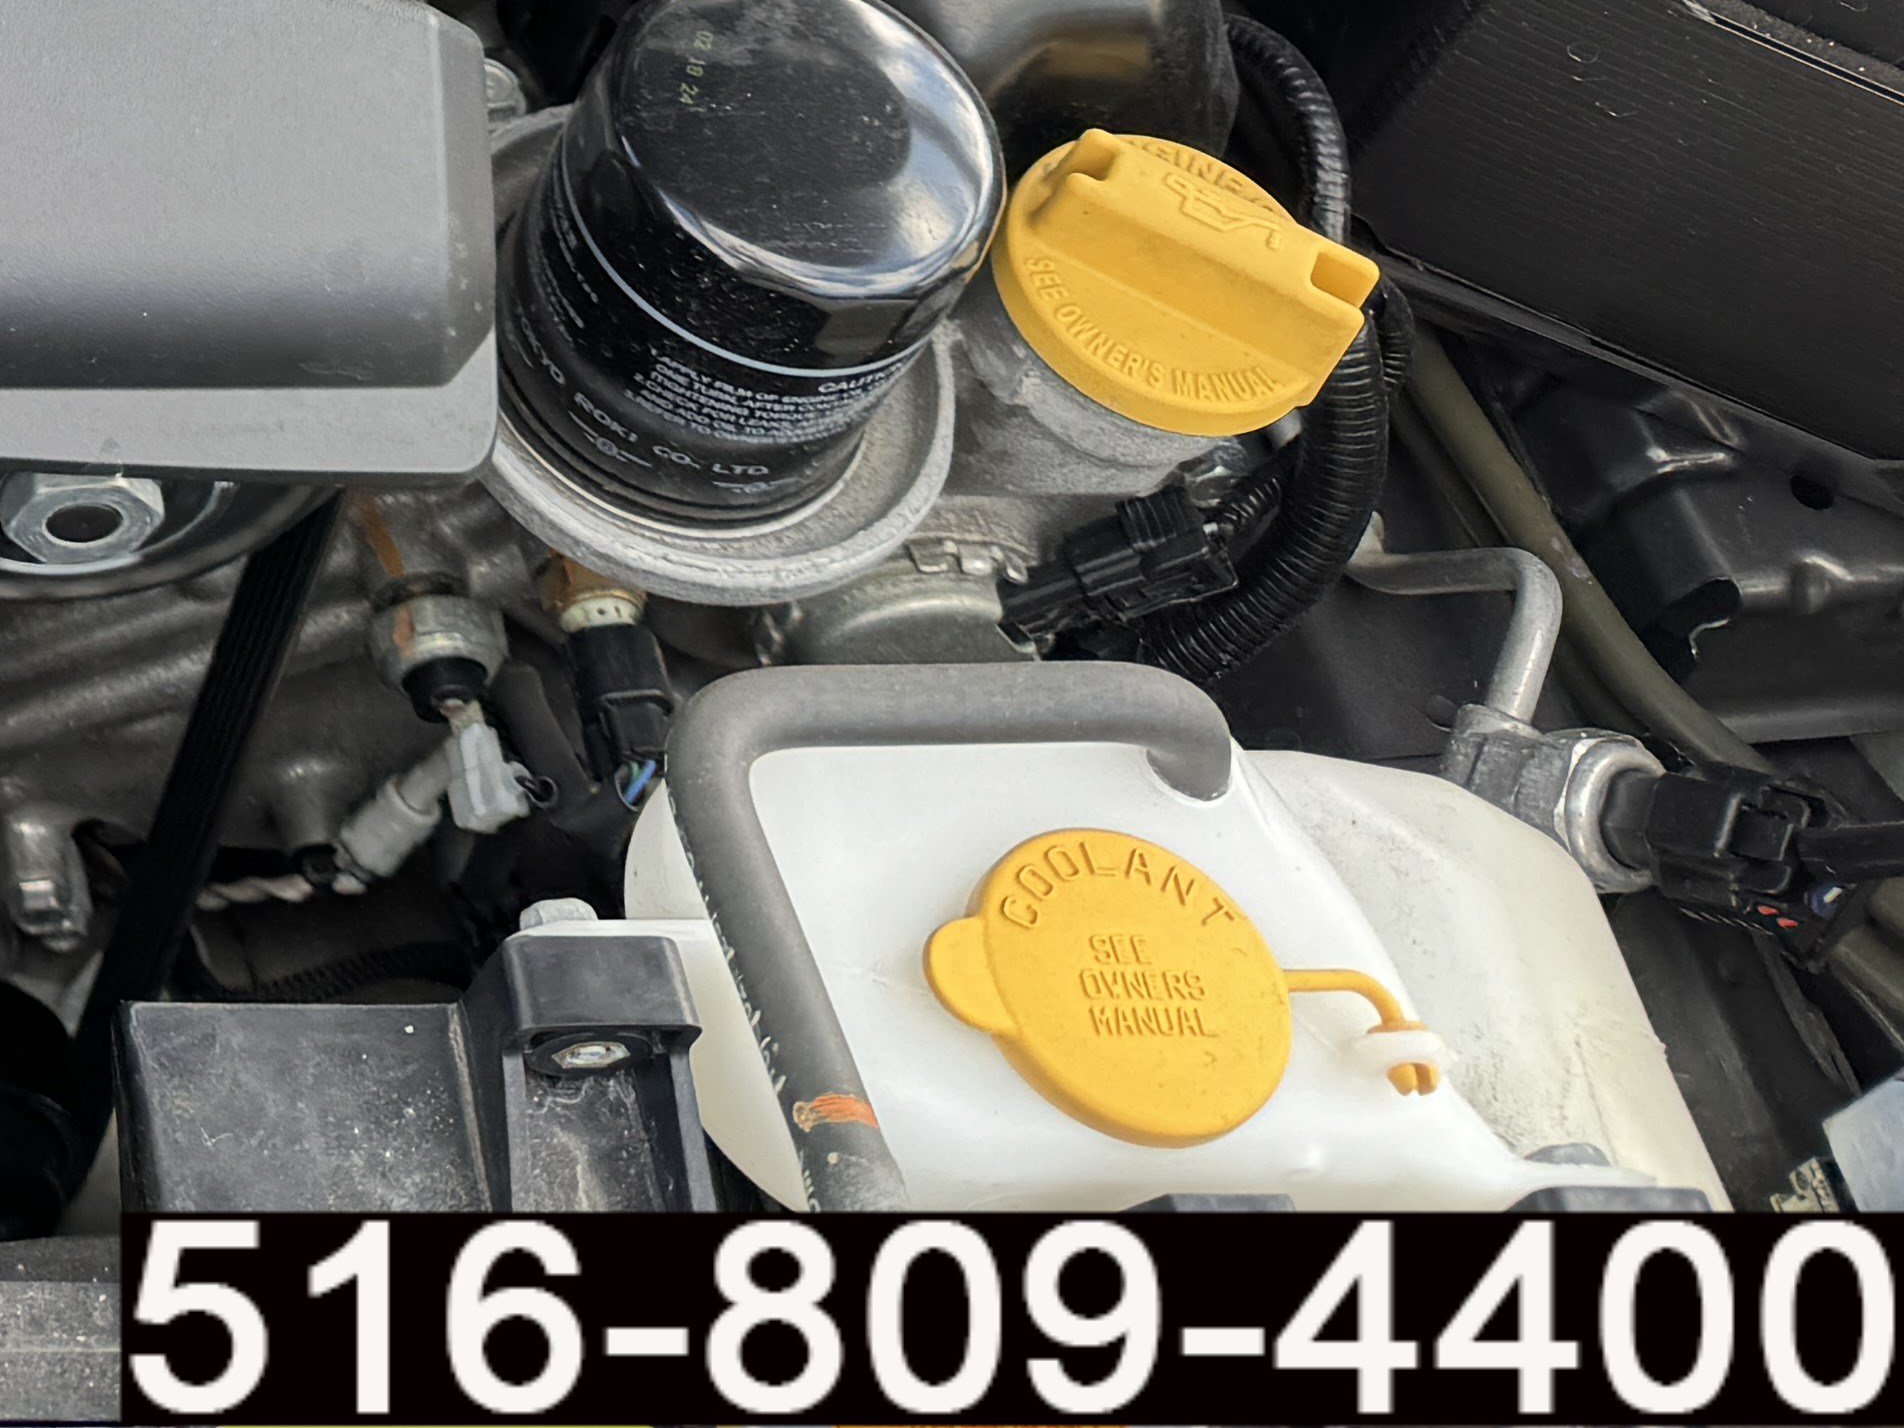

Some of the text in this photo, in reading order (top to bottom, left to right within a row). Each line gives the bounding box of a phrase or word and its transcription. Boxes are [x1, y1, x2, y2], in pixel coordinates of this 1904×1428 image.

[1024, 254, 1281, 403] SEE OWNER'S MANUAL
[1000, 840, 1239, 930] COOLANT
[1087, 933, 1152, 964] SEE
[1078, 969, 1207, 1002] OWNERS
[1088, 1006, 1222, 1038] MANUAL
